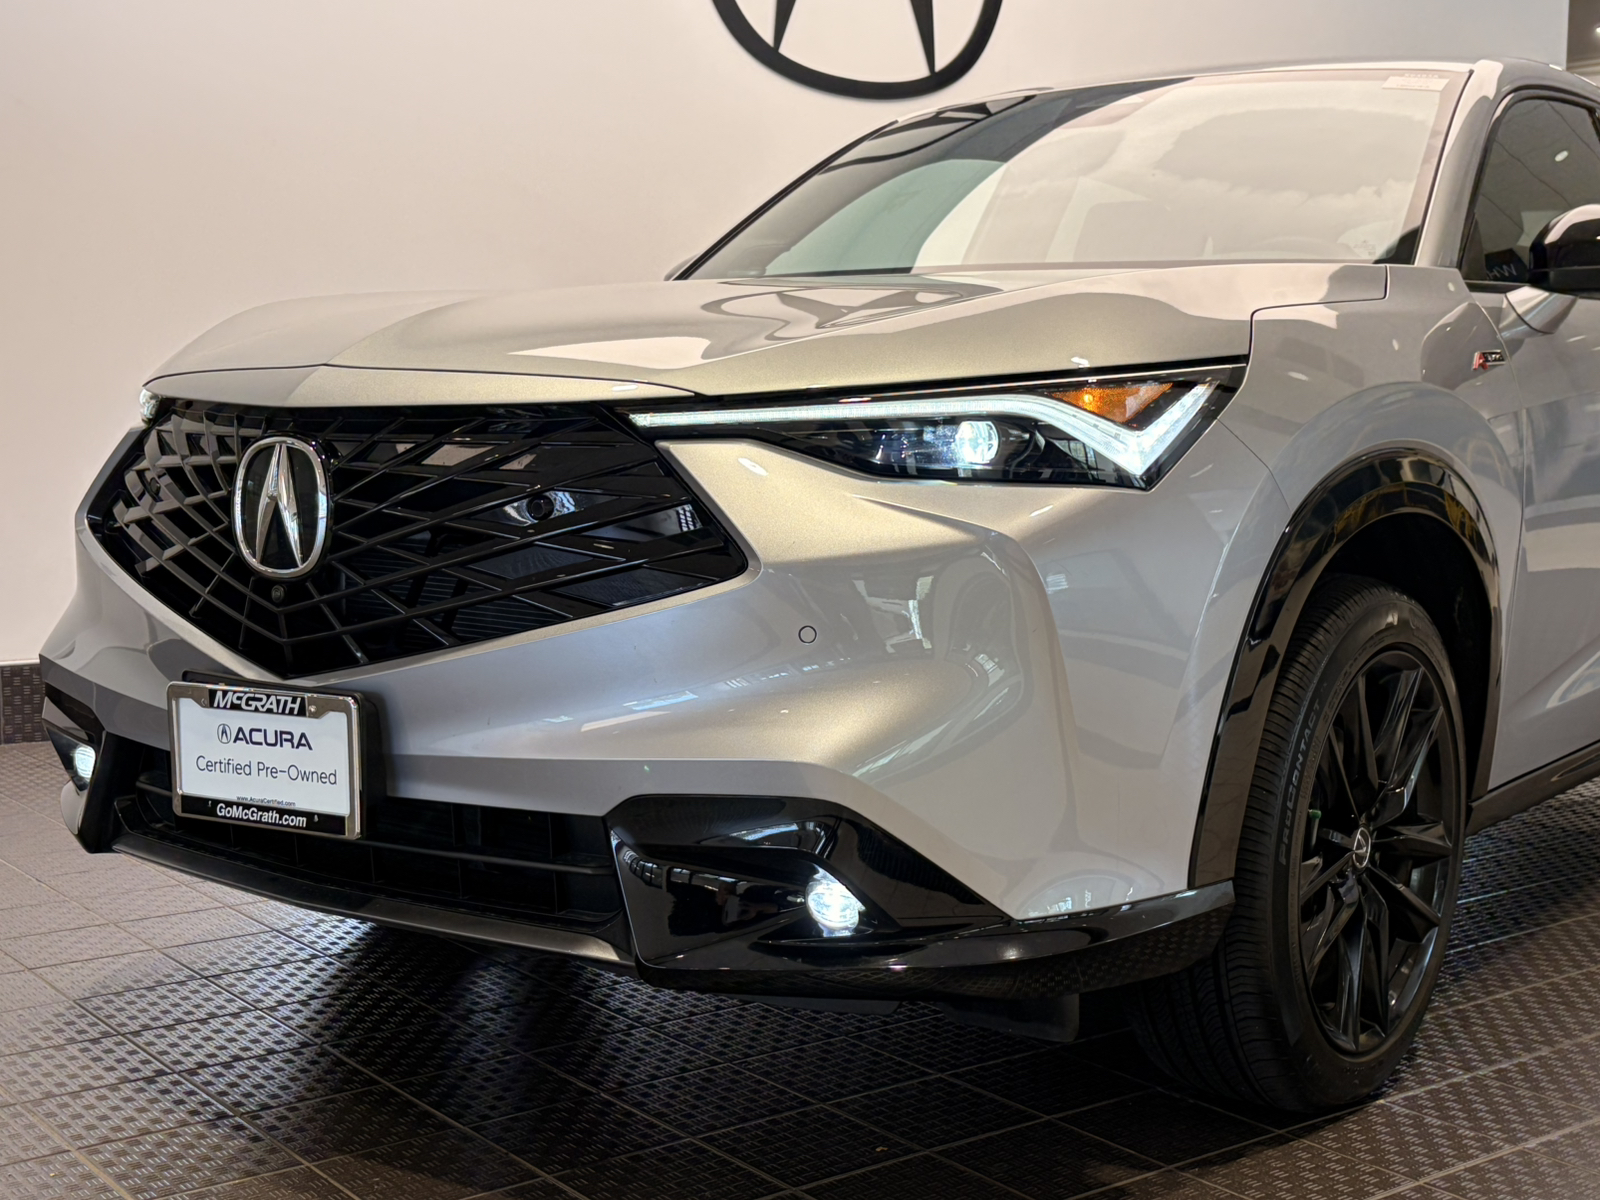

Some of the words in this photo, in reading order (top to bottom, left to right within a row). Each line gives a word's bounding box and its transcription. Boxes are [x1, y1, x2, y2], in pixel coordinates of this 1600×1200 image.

[232, 726, 313, 751] ACURA
[195, 755, 252, 776] Certified
[257, 761, 338, 785] Pre-Owned
[216, 803, 307, 828] GoMcGrath.com
